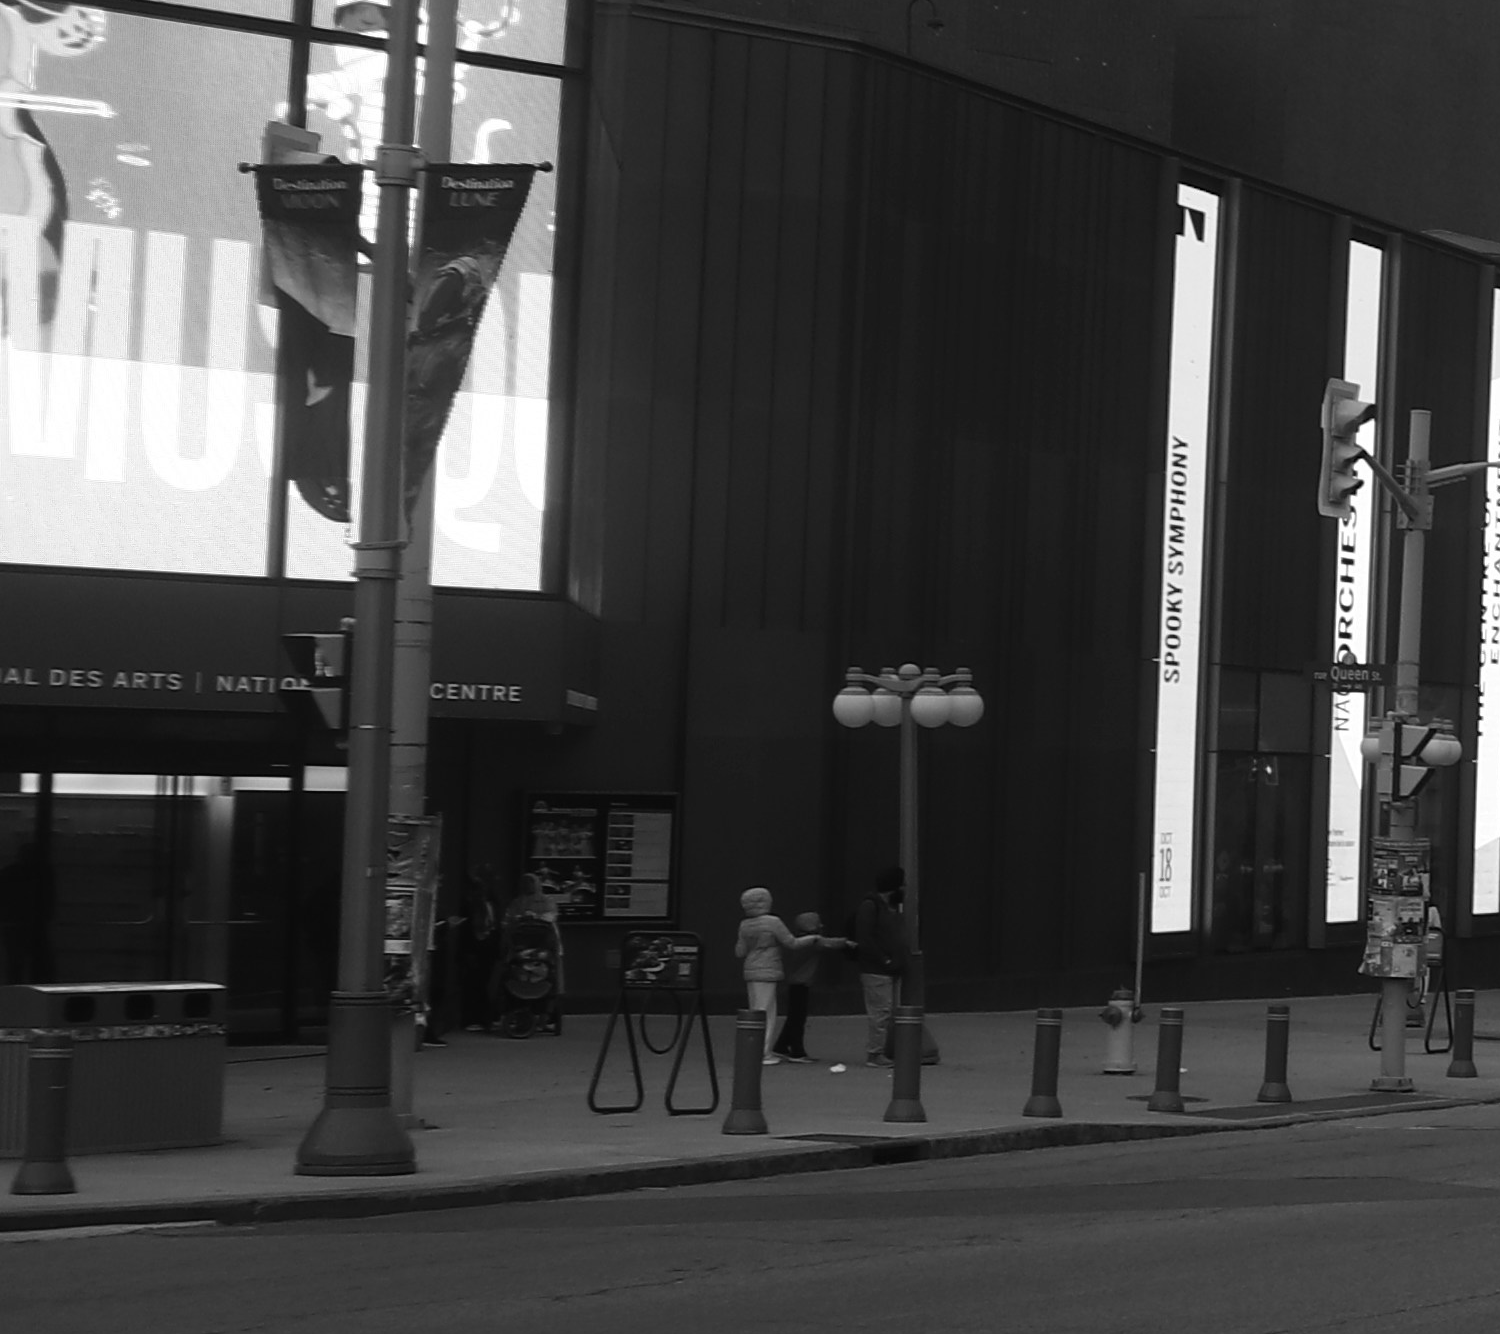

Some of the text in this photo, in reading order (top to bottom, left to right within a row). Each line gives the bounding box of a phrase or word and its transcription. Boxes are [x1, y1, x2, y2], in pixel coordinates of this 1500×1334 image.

[451, 192, 501, 208] LUNE
[1163, 435, 1189, 684] SPOOKY SYMPHONY
[49, 668, 103, 688] DES
[112, 671, 184, 691] ARTS
[1330, 665, 1369, 682] Queen
[428, 681, 523, 703] CENTRE
